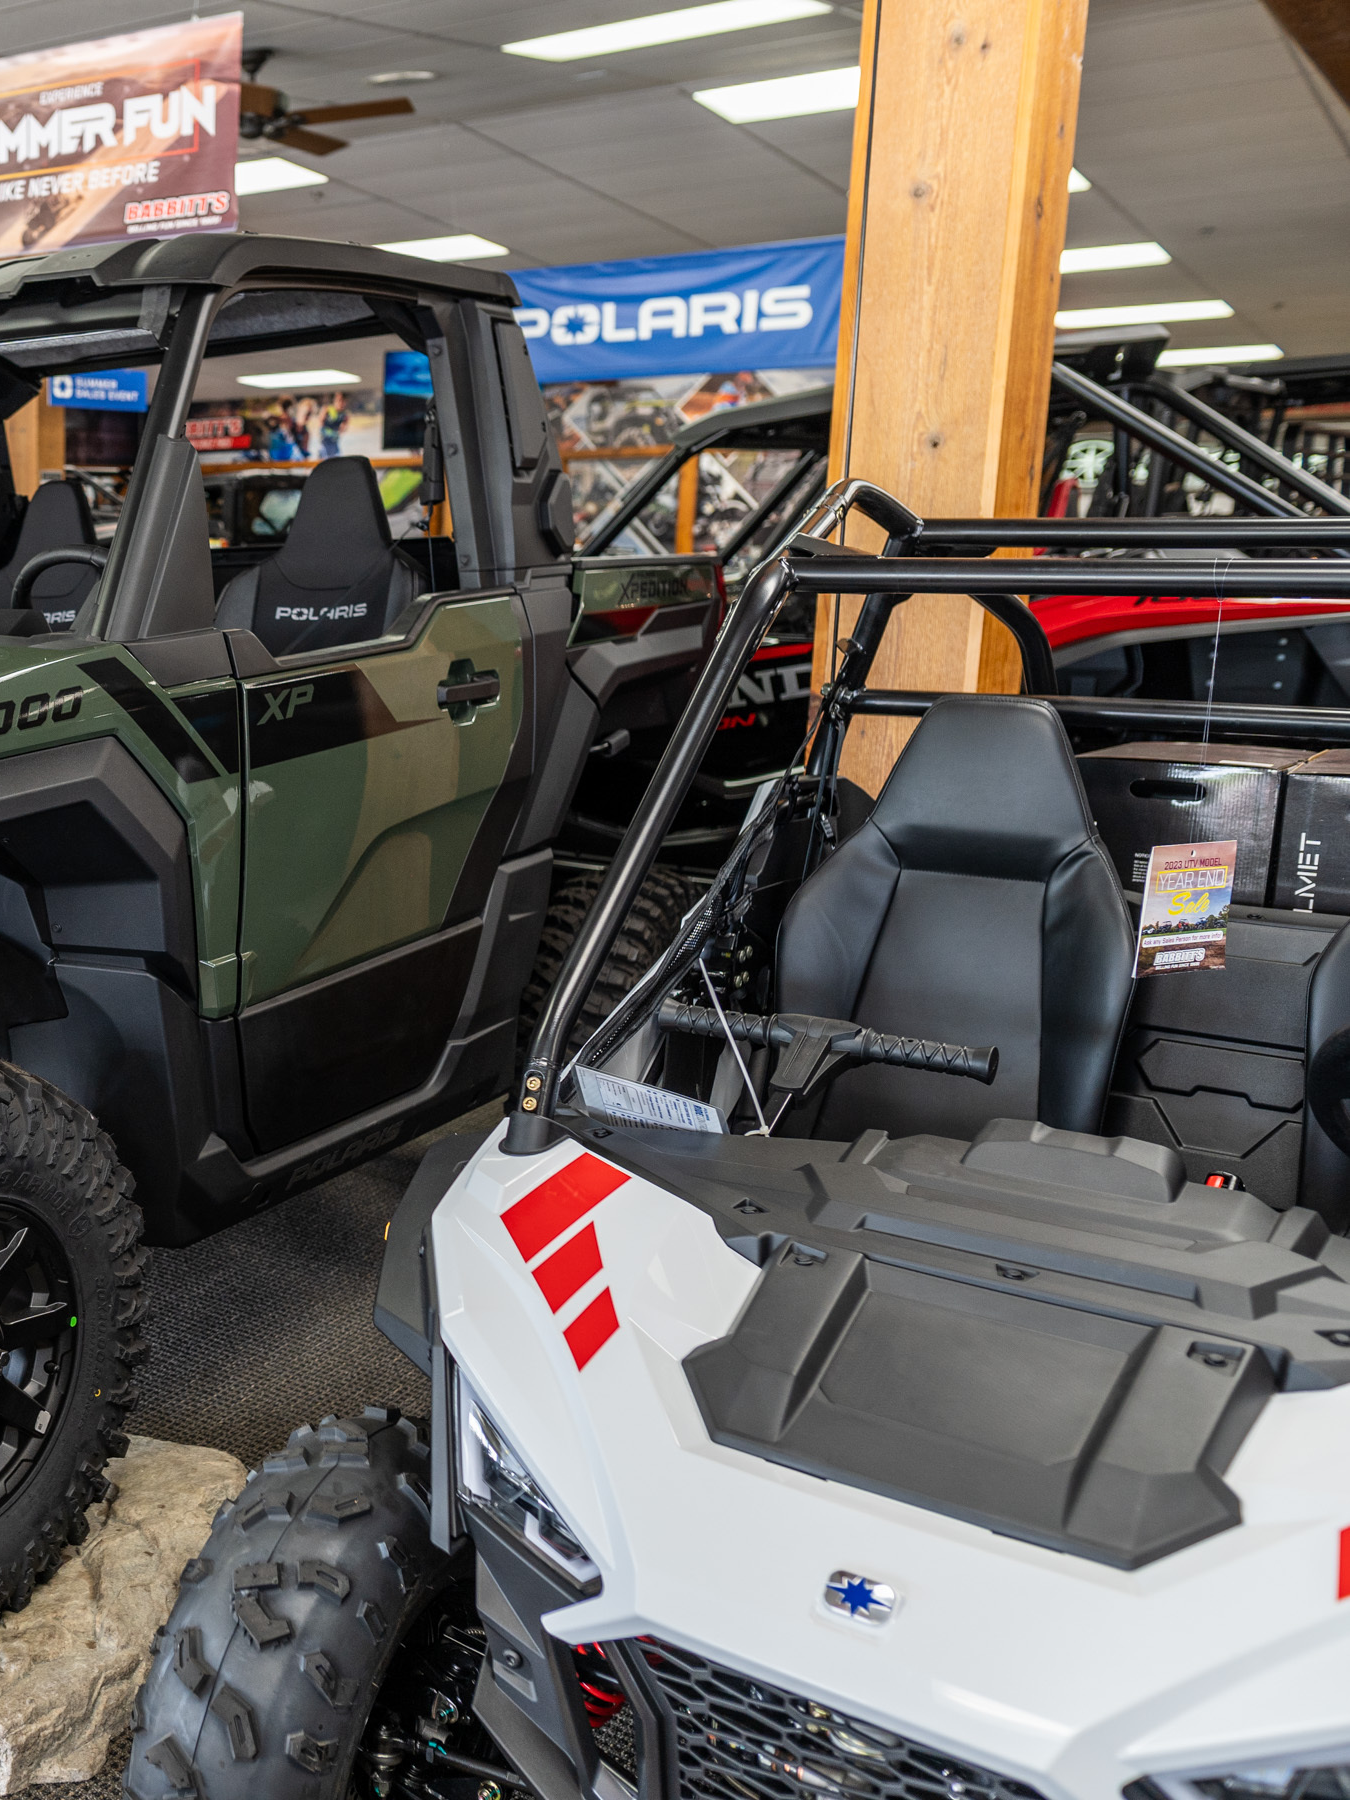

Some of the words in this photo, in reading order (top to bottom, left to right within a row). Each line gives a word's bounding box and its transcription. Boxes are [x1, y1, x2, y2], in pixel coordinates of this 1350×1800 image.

[39, 82, 104, 106] EXPERIENCE
[122, 84, 216, 147] FUN
[27, 170, 84, 199] NEVER
[87, 160, 161, 191] BEFORE
[124, 191, 231, 224] BABBITT'S
[512, 284, 813, 346] POLARIS
[618, 573, 690, 605] XPEDITION
[275, 602, 368, 622] POLARIS
[256, 683, 315, 726] XP
[1164, 860, 1182, 870] 2023
[1184, 859, 1199, 869] UTV
[1199, 857, 1223, 868] MODEL
[1158, 871, 1194, 892] YEAR
[1196, 869, 1225, 888] END
[1167, 891, 1210, 916] Sale
[1153, 947, 1206, 966] BABBITT'S
